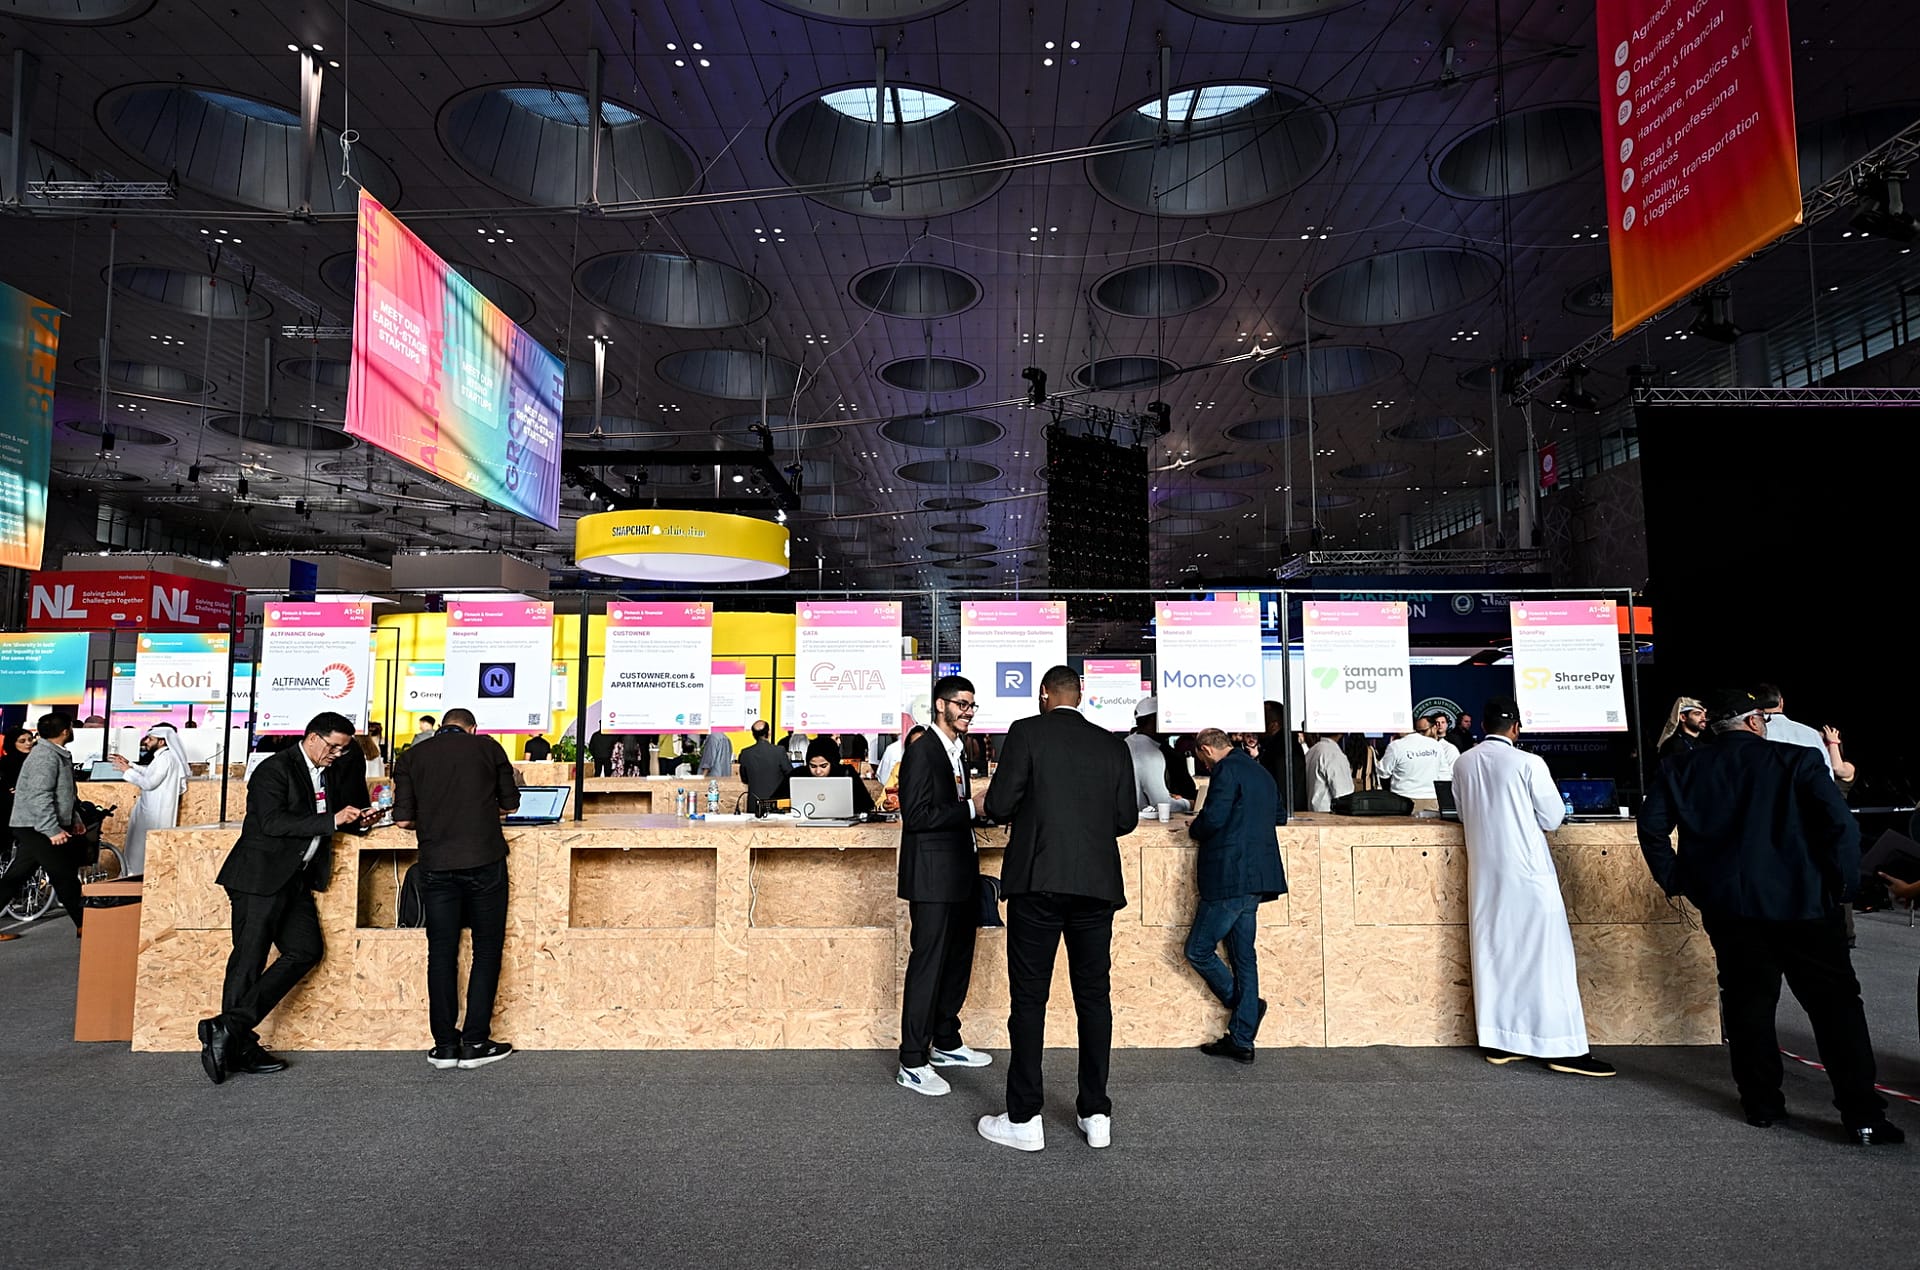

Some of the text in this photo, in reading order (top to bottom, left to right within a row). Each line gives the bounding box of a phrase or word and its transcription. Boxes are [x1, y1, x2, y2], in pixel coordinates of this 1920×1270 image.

[1633, 28, 1675, 73] Charities
[1676, 17, 1684, 31] &
[1635, 9, 1724, 102] Fintech & financial
[1636, 77, 1676, 118] services
[1638, 24, 1753, 142] Hardware, robotics & IoT
[1640, 79, 1739, 171] Legal & professional
[1641, 150, 1679, 188] services
[1642, 111, 1759, 211] Mobility, transportation
[1643, 184, 1690, 227] & logistics
[372, 309, 428, 356] EARLY-STAGE
[380, 300, 421, 338] MEET OUR
[378, 328, 421, 364] STARTUPS
[26, 306, 61, 416] BETA
[462, 360, 493, 389] MEET OUR
[461, 384, 492, 413] STARTUPS
[516, 409, 555, 441] GROWTH-STAGE
[524, 403, 548, 426] MEET OUR
[523, 425, 548, 447] STARTUPS
[612, 525, 650, 536] SNAPCHAT
[31, 585, 87, 619] NL
[83, 590, 105, 598] Solving
[152, 585, 200, 624] NL
[1340, 592, 1432, 602] PAKISTAN
[150, 671, 212, 688] Adori
[272, 678, 330, 686] ALTFINANCE
[490, 674, 503, 687] N
[1005, 670, 1024, 689] R
[1164, 670, 1256, 688] Monexo
[1344, 665, 1404, 677] tamam
[1555, 672, 1615, 684] SharePay
[1100, 696, 1136, 704] FundCube
[1345, 679, 1377, 693] pay
